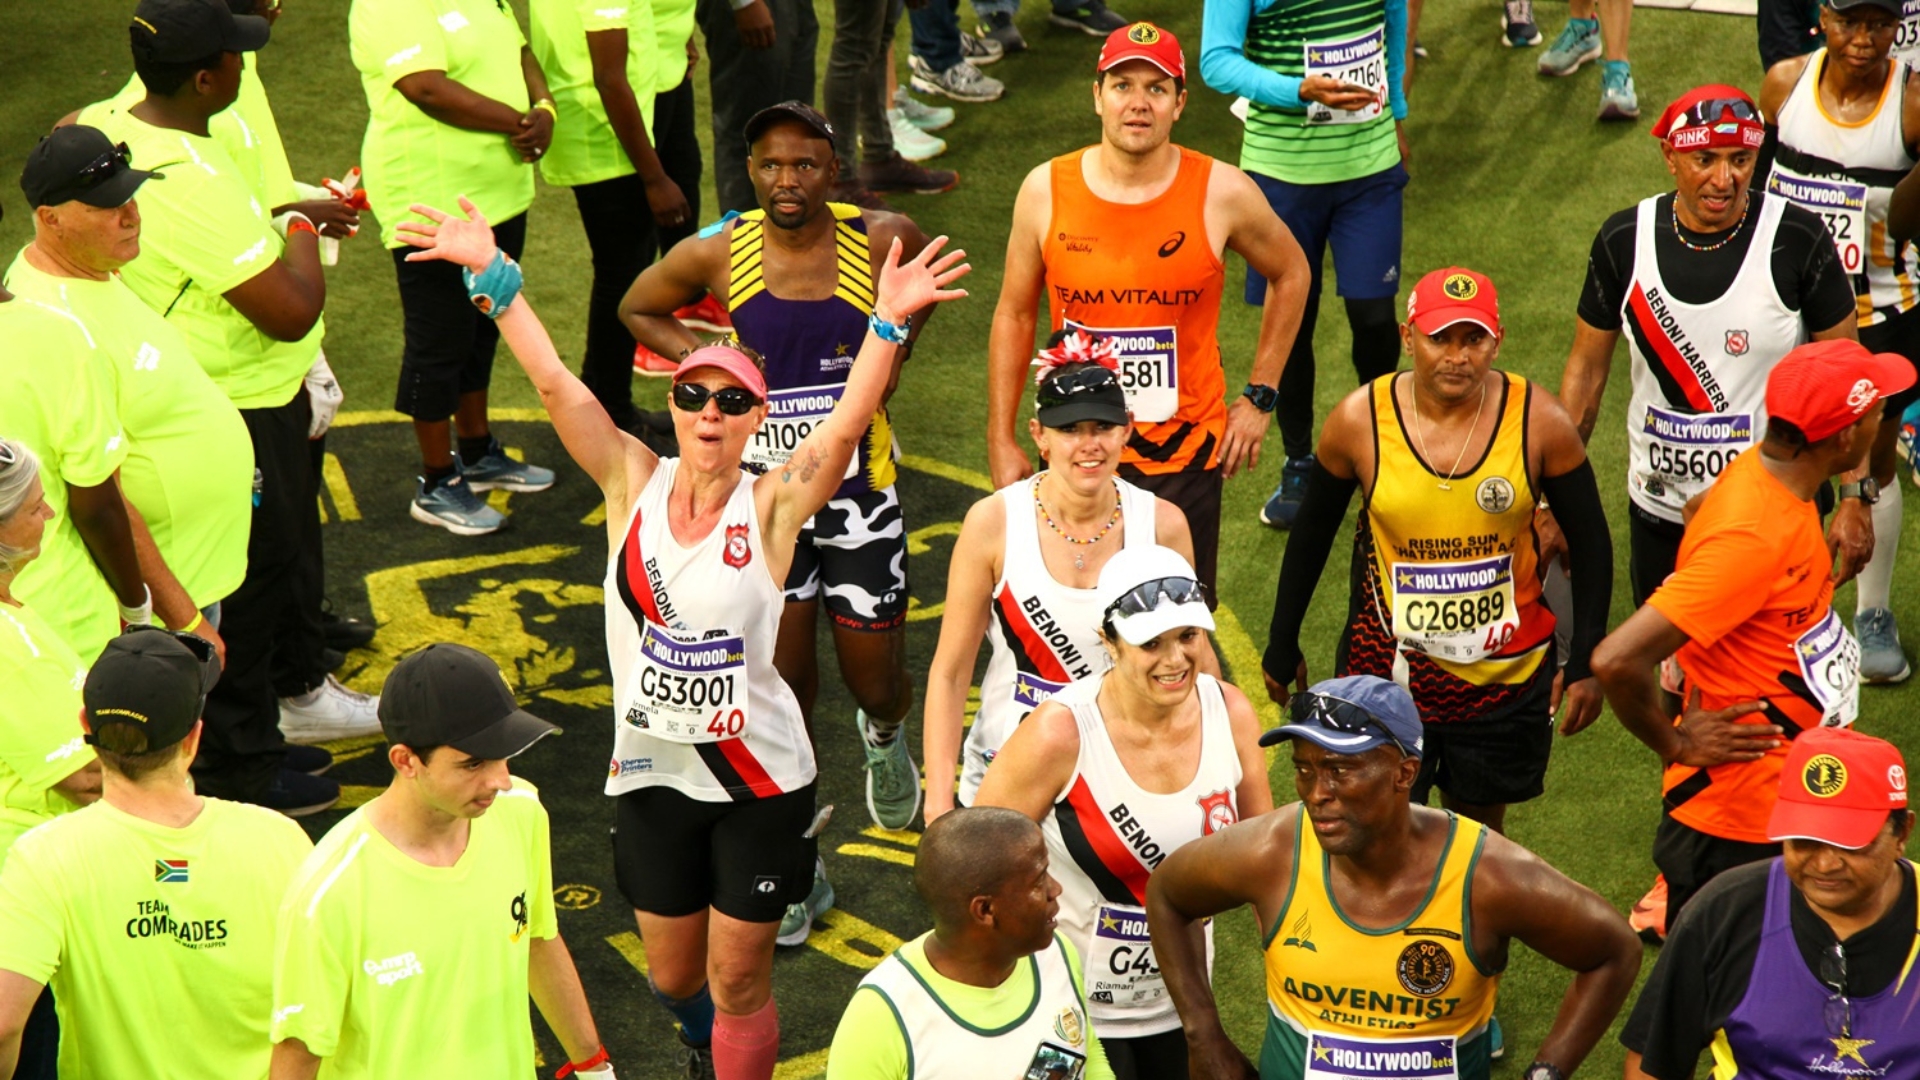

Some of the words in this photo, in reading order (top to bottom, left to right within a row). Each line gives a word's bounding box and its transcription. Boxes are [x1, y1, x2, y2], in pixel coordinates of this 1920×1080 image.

[1894, 21, 1917, 47] 03
[1676, 129, 1706, 145] PINK
[1825, 213, 1851, 239] 32
[1836, 243, 1860, 270] 0
[1055, 285, 1104, 304] TEAM
[1110, 287, 1204, 305] VITALITY
[1646, 287, 1686, 344] BENONI
[1679, 341, 1729, 413] HARRIERS
[768, 395, 839, 414] OLLYWOOD
[755, 419, 824, 450] H109
[1656, 418, 1750, 439] HOLLYWOODbets
[1408, 538, 1462, 550] RISING
[1468, 533, 1498, 546] SUN
[645, 556, 677, 622] BENONI
[1406, 591, 1504, 631] G26889
[1022, 595, 1082, 666] BENONI
[1483, 622, 1515, 652] 40
[653, 641, 744, 667] HOLLYWOODbets
[641, 666, 734, 707] G53001
[628, 709, 647, 721] ASA
[707, 708, 745, 738] 40
[137, 899, 169, 915] TEAM
[126, 914, 228, 942] COMRADES
[1095, 981, 1134, 990] Riamari
[1284, 976, 1460, 1020] ADVENTIST
[1333, 1049, 1453, 1071] HOLLYWOODbets
[1805, 1054, 1893, 1077] Hollywood
